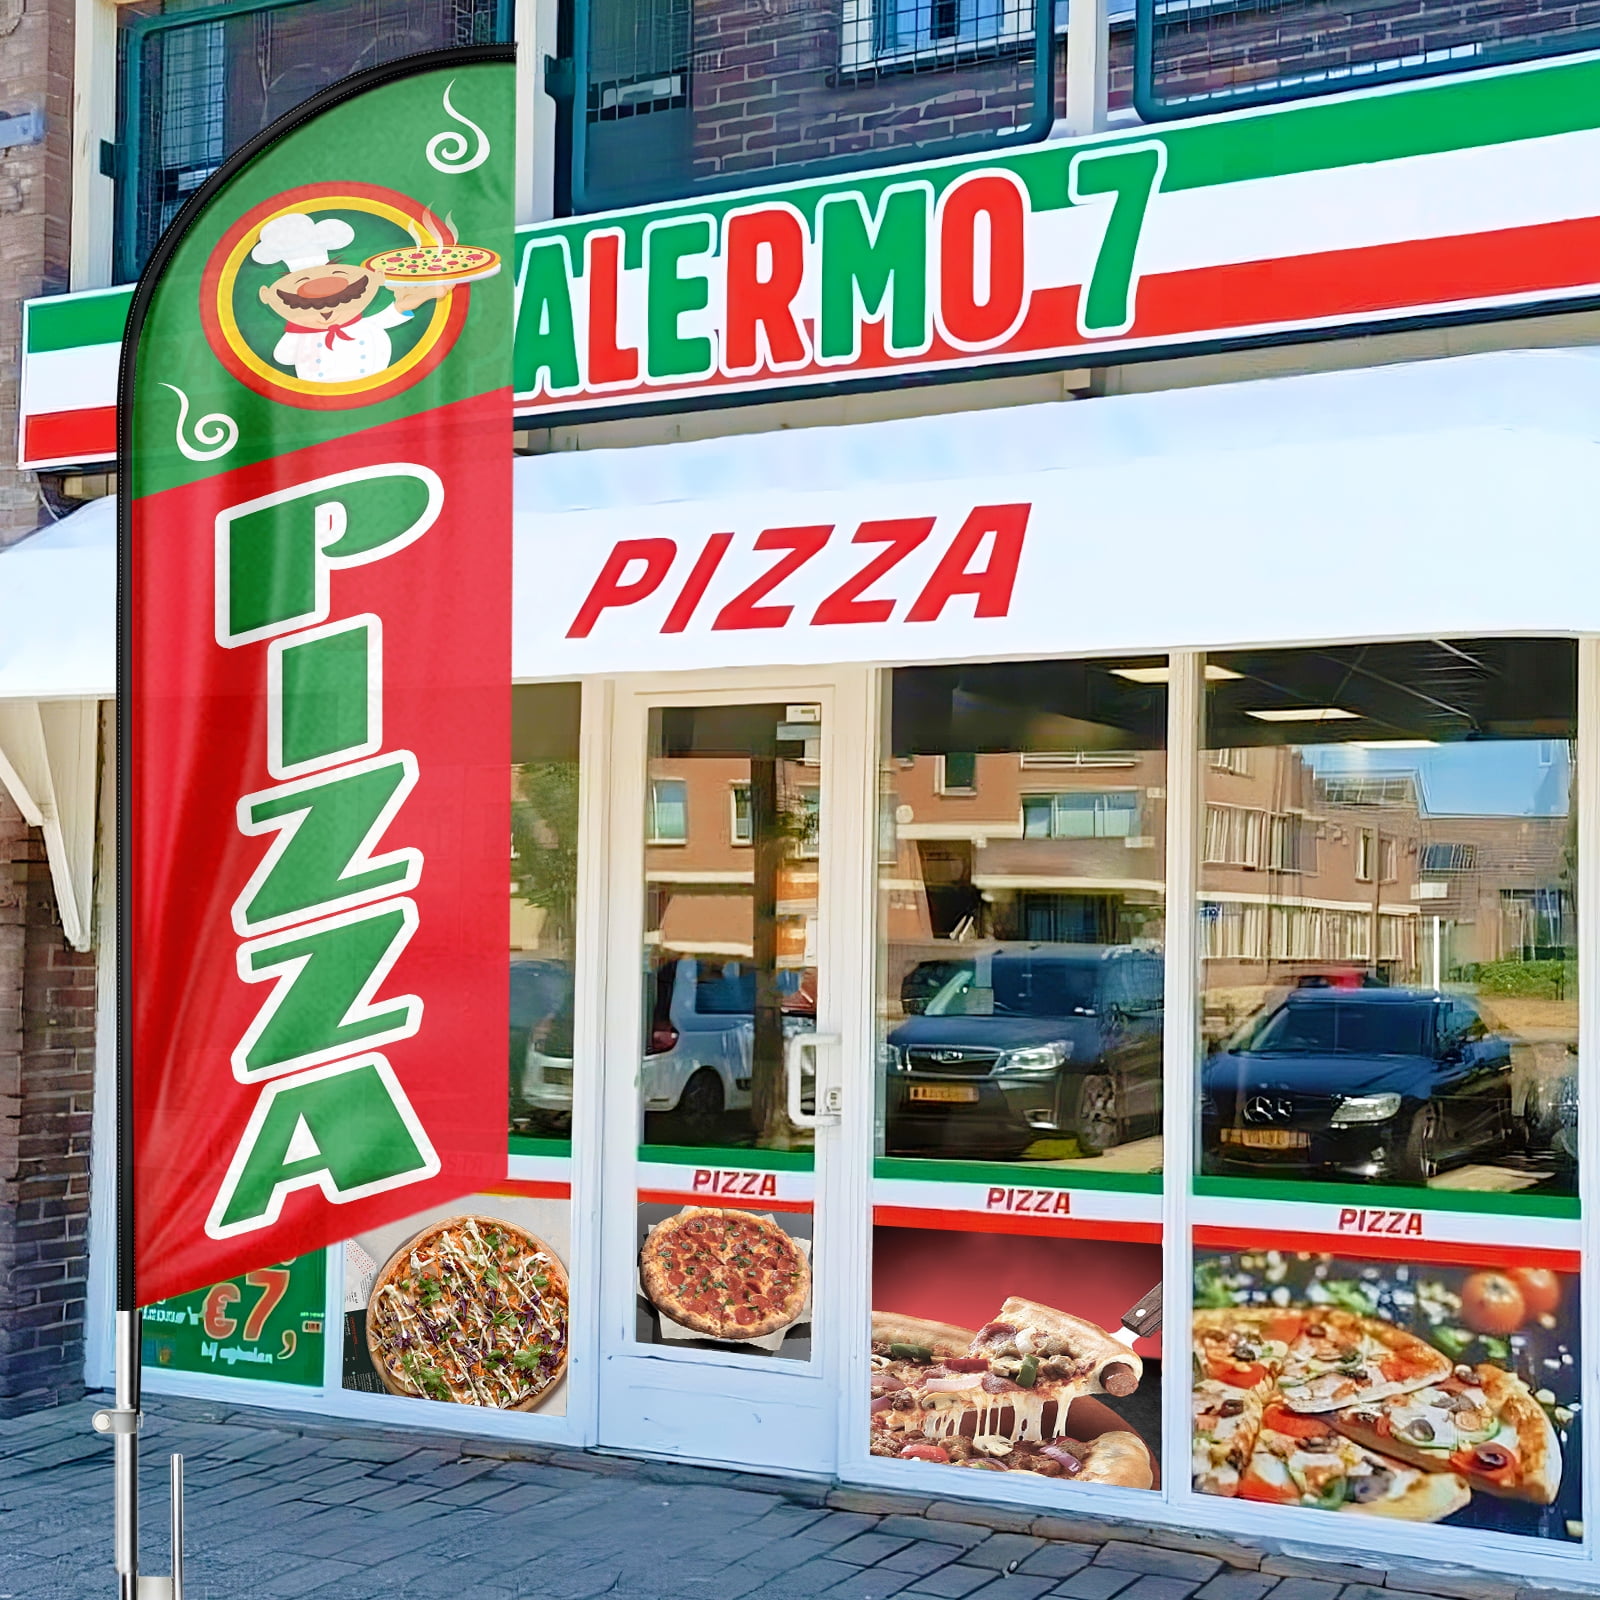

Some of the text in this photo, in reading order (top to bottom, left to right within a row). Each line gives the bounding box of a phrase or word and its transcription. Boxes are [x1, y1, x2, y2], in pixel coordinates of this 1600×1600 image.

[513, 140, 1166, 398] ALERMO 7
[565, 502, 1032, 639] PIZZA
[206, 463, 443, 1239] PIZZA
[693, 1169, 777, 1197] PIZZA
[986, 1187, 1071, 1215] PIZZA
[1339, 1208, 1423, 1236] PIZZA
